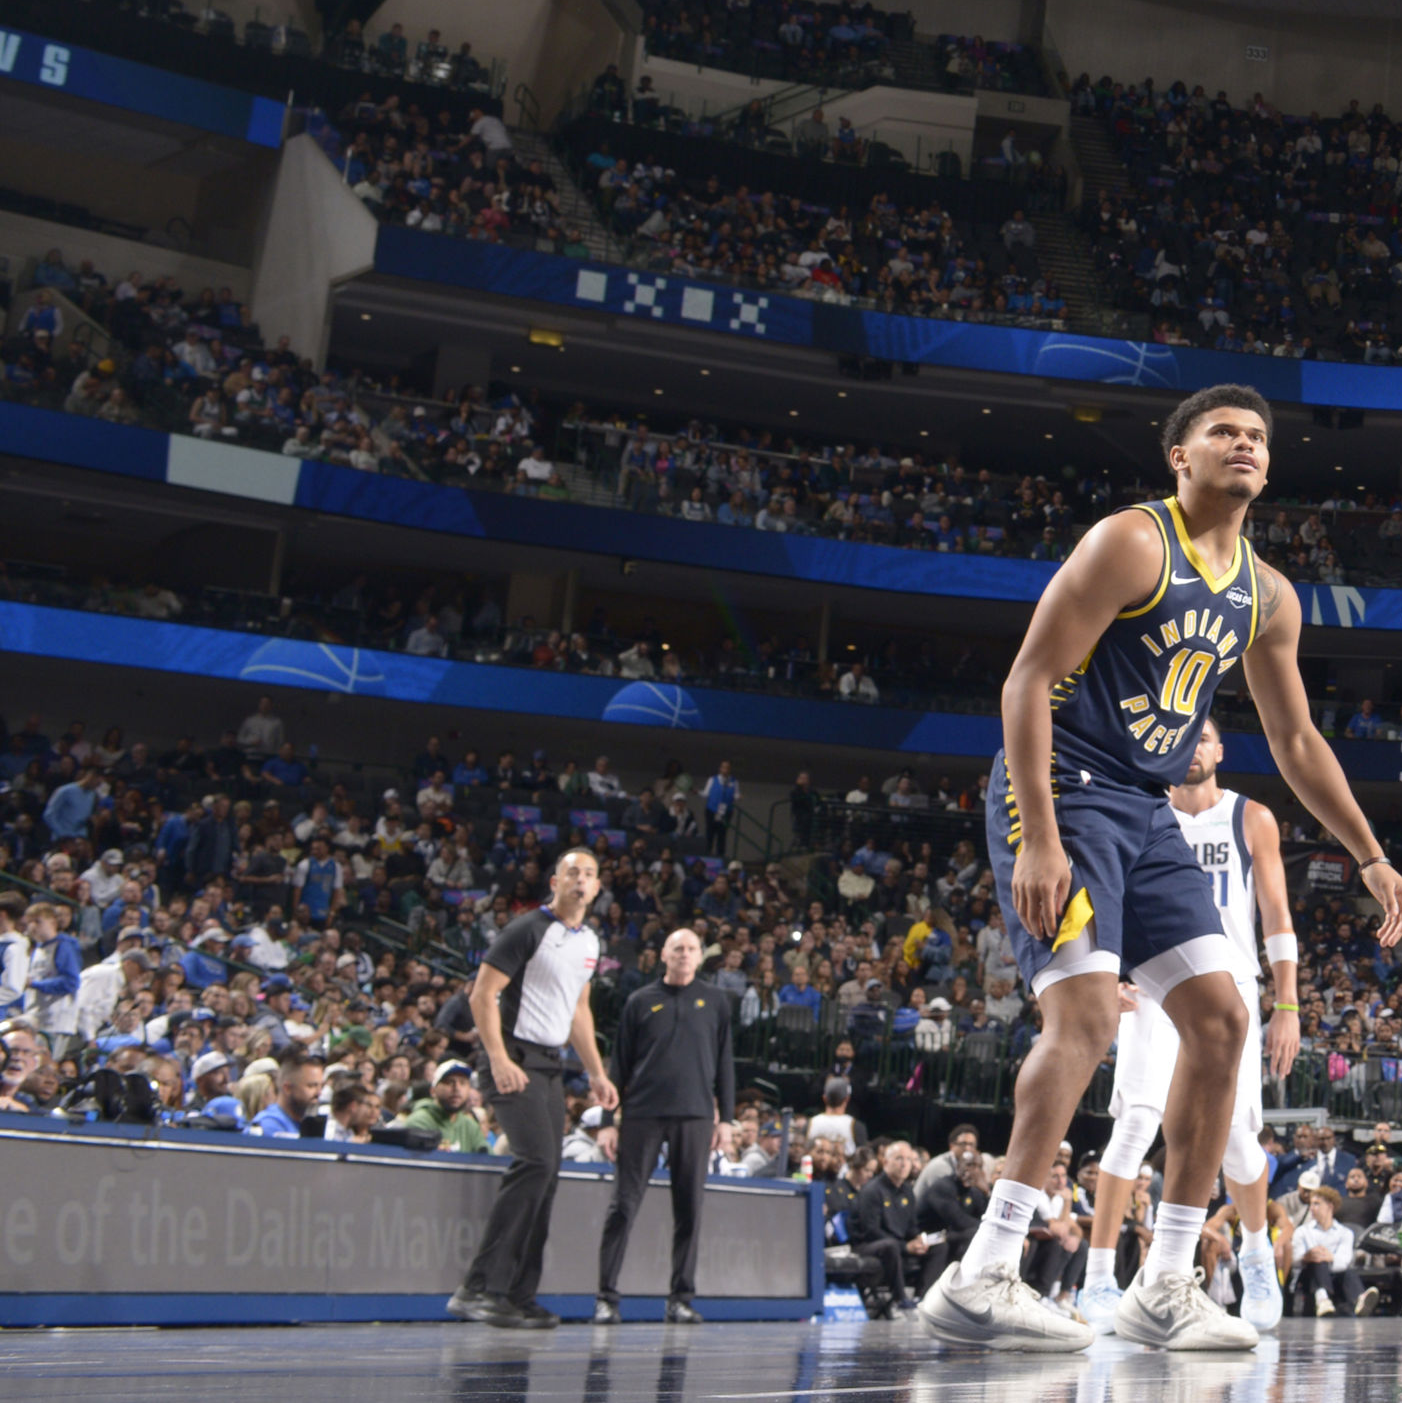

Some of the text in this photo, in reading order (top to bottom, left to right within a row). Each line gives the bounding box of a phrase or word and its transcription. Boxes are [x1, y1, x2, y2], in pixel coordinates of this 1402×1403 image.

[1141, 609, 1238, 675] INDIANA
[1160, 647, 1215, 716] 10
[129, 1190, 209, 1266] the
[226, 1186, 353, 1267] Dallas
